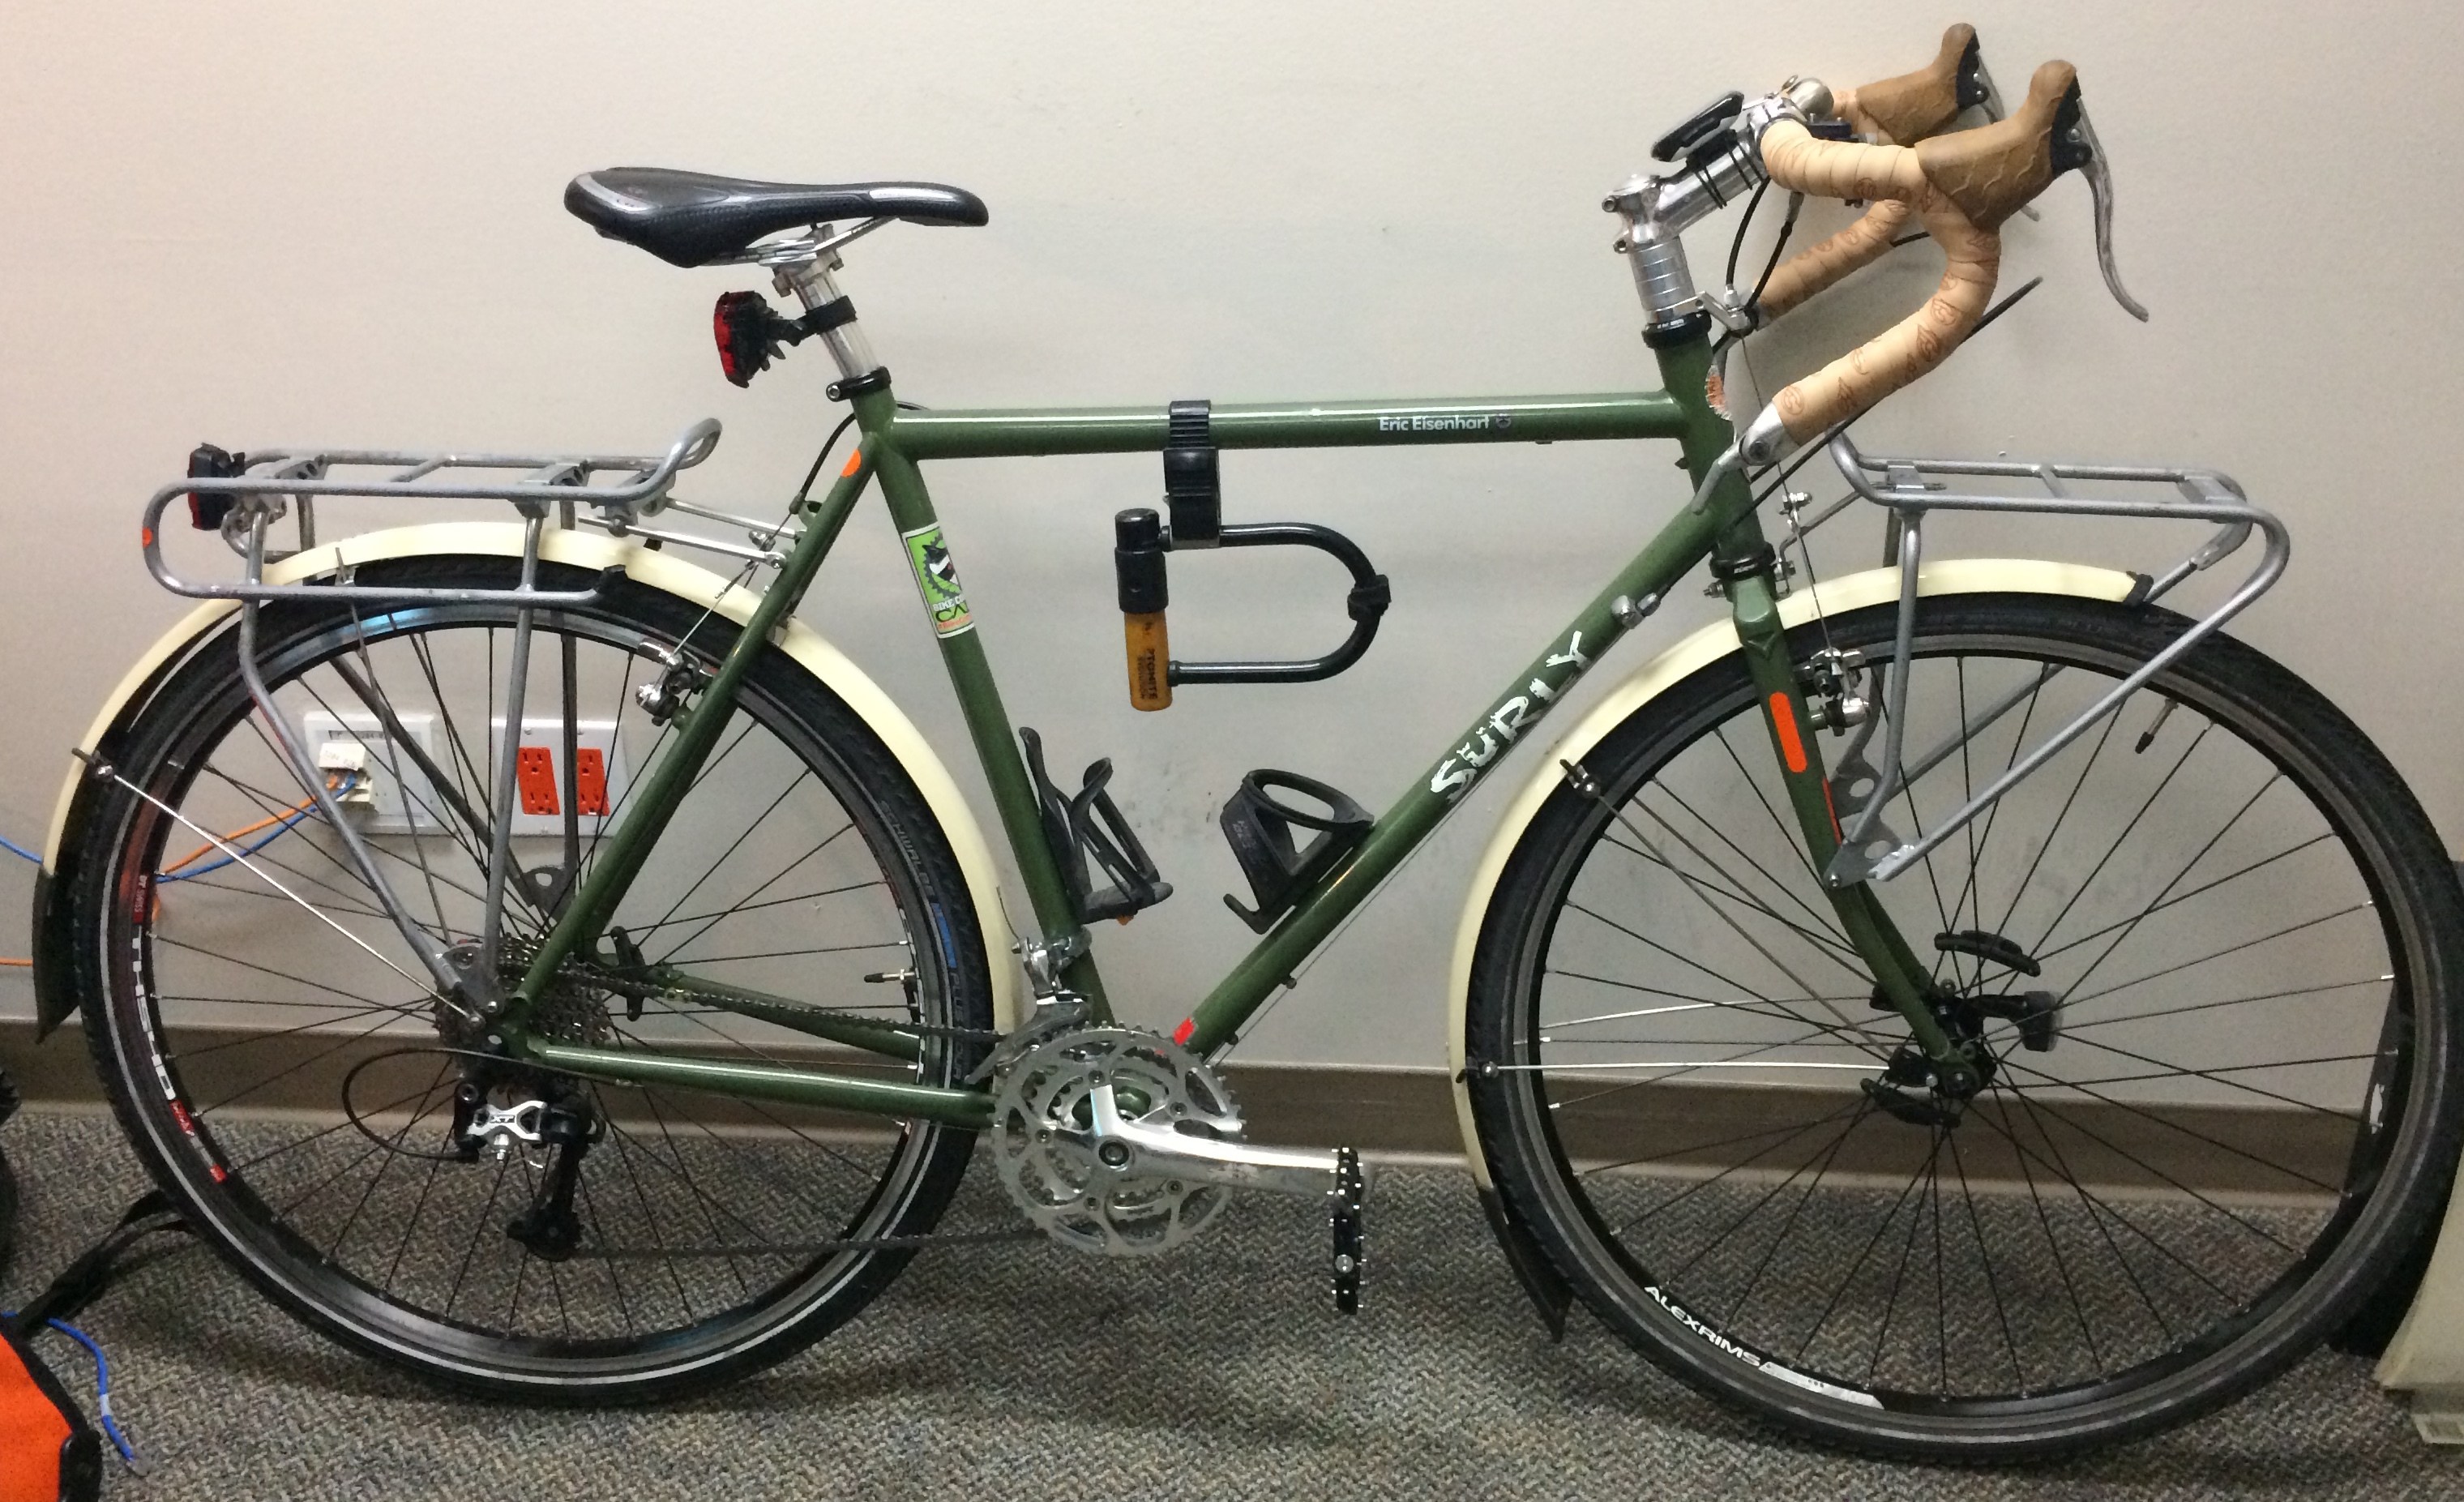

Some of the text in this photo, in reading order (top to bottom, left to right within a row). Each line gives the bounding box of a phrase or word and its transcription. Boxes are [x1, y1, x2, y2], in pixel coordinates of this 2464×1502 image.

[1380, 415, 1490, 431] Eric Eisenhart
[933, 599, 955, 612] BIKE
[880, 800, 935, 896] SCHWALBE
[138, 875, 148, 888] DT
[951, 973, 964, 1080] PLUS OUR
[490, 1115, 515, 1123] XT
[1644, 1286, 1761, 1367] ALEXRIMS
